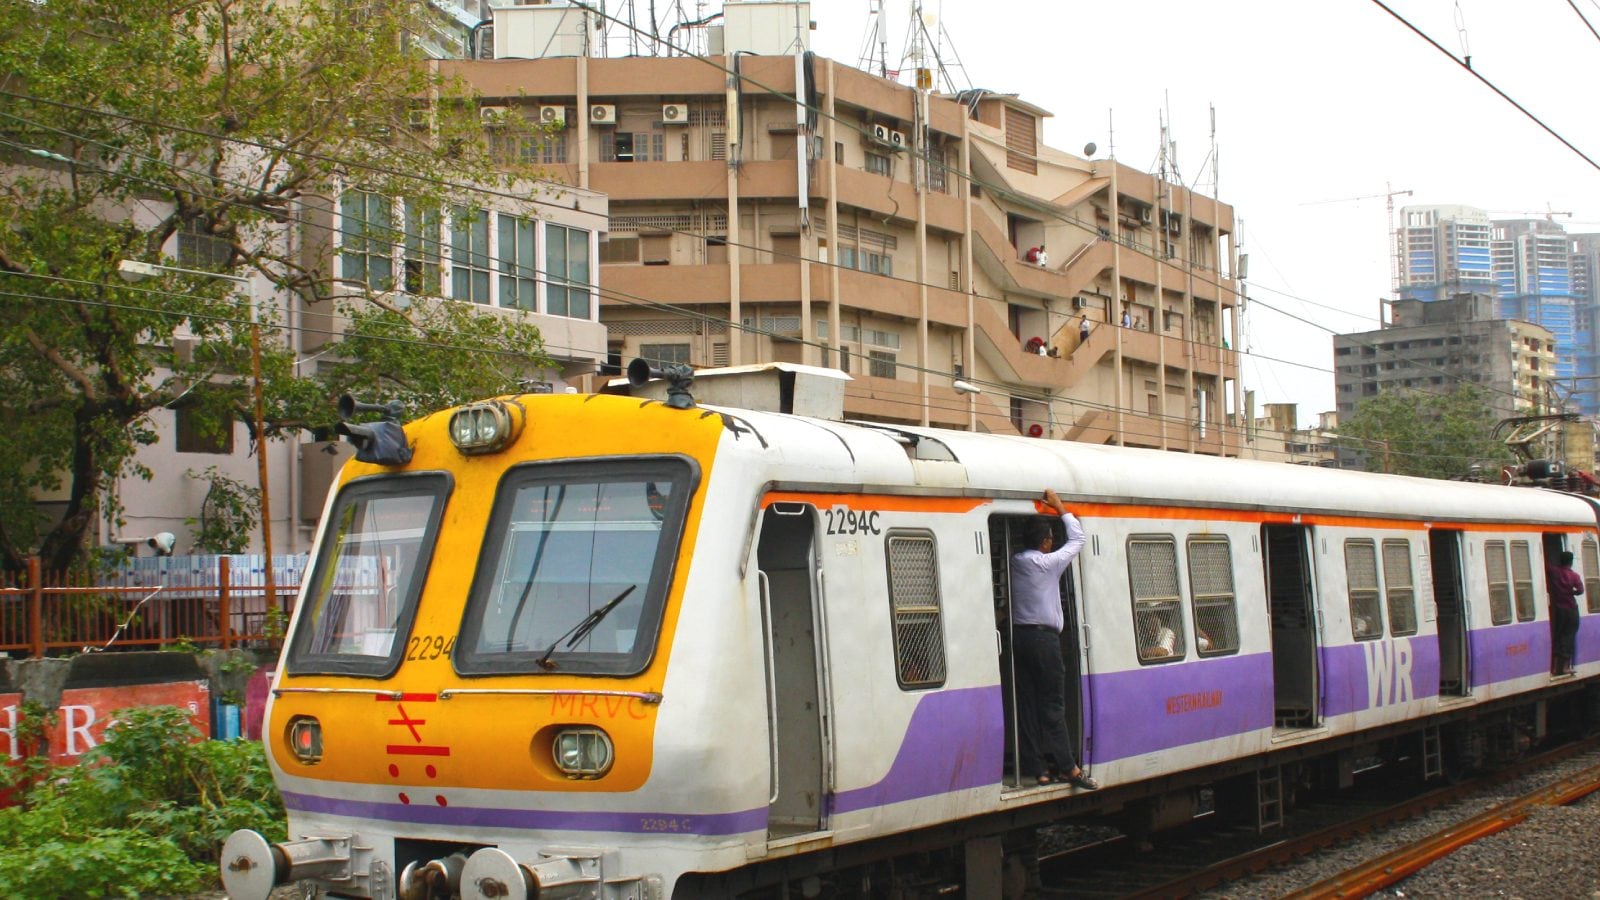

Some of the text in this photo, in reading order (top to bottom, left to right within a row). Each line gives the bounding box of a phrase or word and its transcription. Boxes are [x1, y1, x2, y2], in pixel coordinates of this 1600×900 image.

[825, 508, 880, 536] 2294C
[407, 635, 456, 661] 2294
[1363, 637, 1414, 708] WR
[550, 692, 648, 720] MRVC
